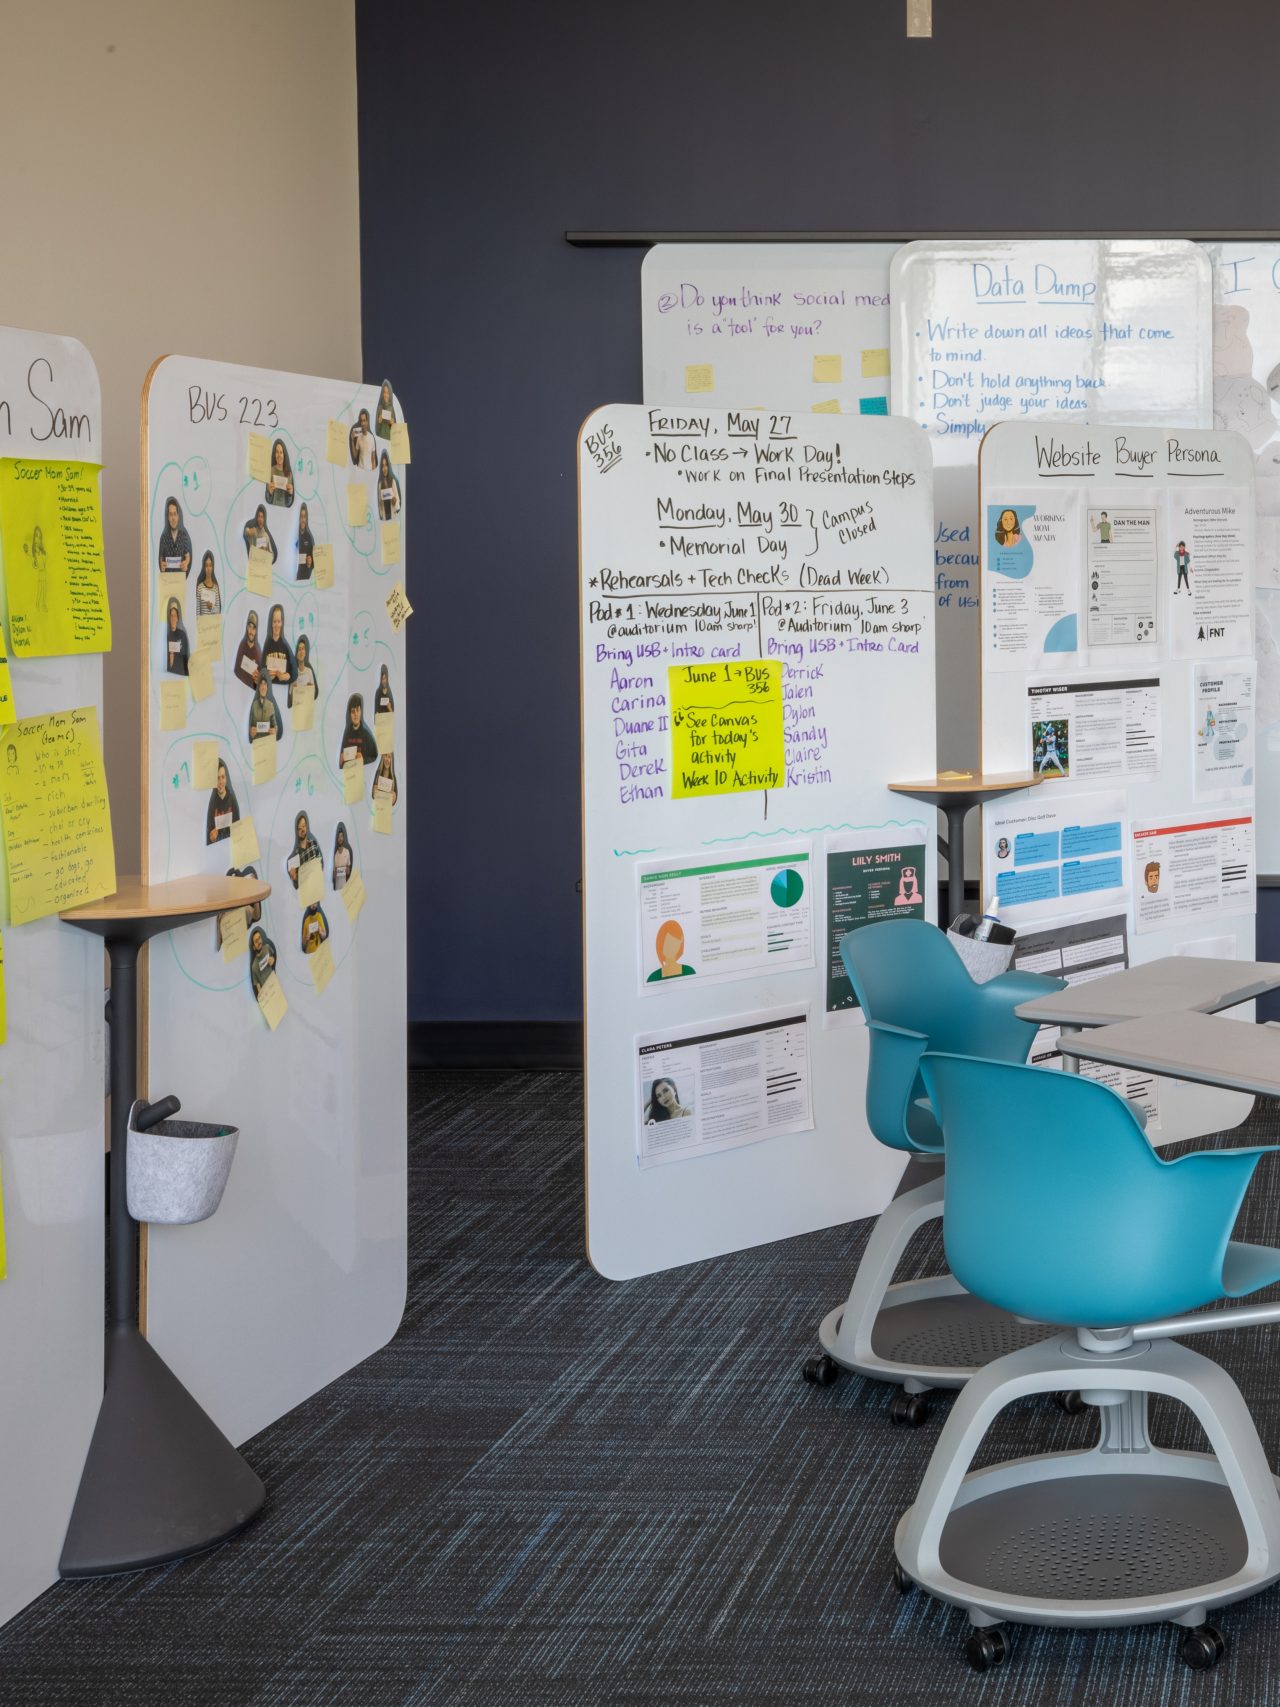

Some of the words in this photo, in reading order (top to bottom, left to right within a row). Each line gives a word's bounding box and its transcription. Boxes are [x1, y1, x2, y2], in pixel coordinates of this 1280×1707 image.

[973, 264, 1024, 297] Data
[1035, 264, 1096, 301] Dump
[1221, 257, 1255, 294] I
[680, 283, 704, 308] Do
[712, 297, 736, 316] you
[742, 287, 781, 307] think
[796, 291, 845, 306] social
[687, 319, 702, 334] is
[791, 320, 822, 338] you?
[927, 316, 979, 341] Write
[984, 323, 1024, 339] down
[1029, 320, 1047, 339] all
[1056, 321, 1093, 339] ideas
[1100, 322, 1134, 341] that
[1139, 327, 1174, 339] come
[930, 349, 942, 362] to
[932, 370, 973, 389] Don't
[981, 374, 1010, 388] hold
[1016, 375, 1071, 394] anything
[28, 358, 91, 442] Sam
[933, 393, 970, 409] Don't
[977, 395, 1012, 412] judge
[1021, 397, 1049, 414] your
[1056, 398, 1088, 409] ideas
[240, 398, 280, 427] 223
[728, 413, 759, 440] May
[770, 416, 791, 434] 27
[937, 412, 986, 438] Simply
[654, 444, 676, 463] No
[681, 445, 729, 461] Class
[754, 445, 794, 463] Work
[804, 444, 841, 471] Day!
[1035, 435, 1100, 468] Website
[1115, 437, 1157, 470] Buyer
[1167, 439, 1221, 463] Persona
[15, 461, 42, 480] Soccer
[45, 466, 62, 478] Mom
[730, 471, 745, 482] on
[755, 468, 791, 483] Final
[799, 468, 880, 483] Presentation
[883, 471, 915, 486] Steps
[657, 497, 732, 527] Monday,
[737, 502, 773, 532] May
[780, 502, 798, 522] 30
[822, 501, 873, 530] Campus
[839, 519, 876, 544] Closed
[669, 537, 746, 555] Memorial
[758, 537, 788, 559] Day
[698, 568, 732, 585] Tech
[738, 566, 790, 585] Checks
[800, 564, 841, 587] (Dead
[848, 566, 890, 586] Week)
[935, 573, 968, 590] from
[762, 596, 782, 616] Pod
[866, 597, 895, 614] June
[939, 594, 952, 607] of
[590, 601, 612, 623] Pod
[645, 601, 721, 623] Wednesday
[724, 601, 747, 618] June
[1210, 628, 1225, 637] FNT
[596, 644, 633, 666] Bring
[637, 642, 661, 657] USB
[711, 643, 740, 657] card
[768, 638, 803, 663] Bring
[810, 639, 835, 650] USB
[888, 637, 919, 653] Card
[610, 668, 653, 690] Aaron
[684, 666, 716, 684] June
[747, 683, 769, 694] 356
[612, 694, 666, 713] Carina
[72, 711, 86, 724] Sam
[614, 715, 655, 736] Duane
[686, 712, 707, 729] See
[711, 714, 758, 727] Canvas
[690, 730, 707, 745] for
[713, 727, 759, 746] today's
[784, 726, 827, 748] Sandy
[616, 742, 647, 760] Gita
[692, 750, 736, 766] activity
[785, 747, 822, 766] Claire
[620, 759, 667, 781] Derek
[682, 771, 708, 788] Week
[715, 771, 726, 785] 10
[733, 770, 779, 788] Activity
[787, 768, 832, 788] Kristin
[620, 785, 663, 804] Ethan
[876, 853, 901, 864] SMITH
